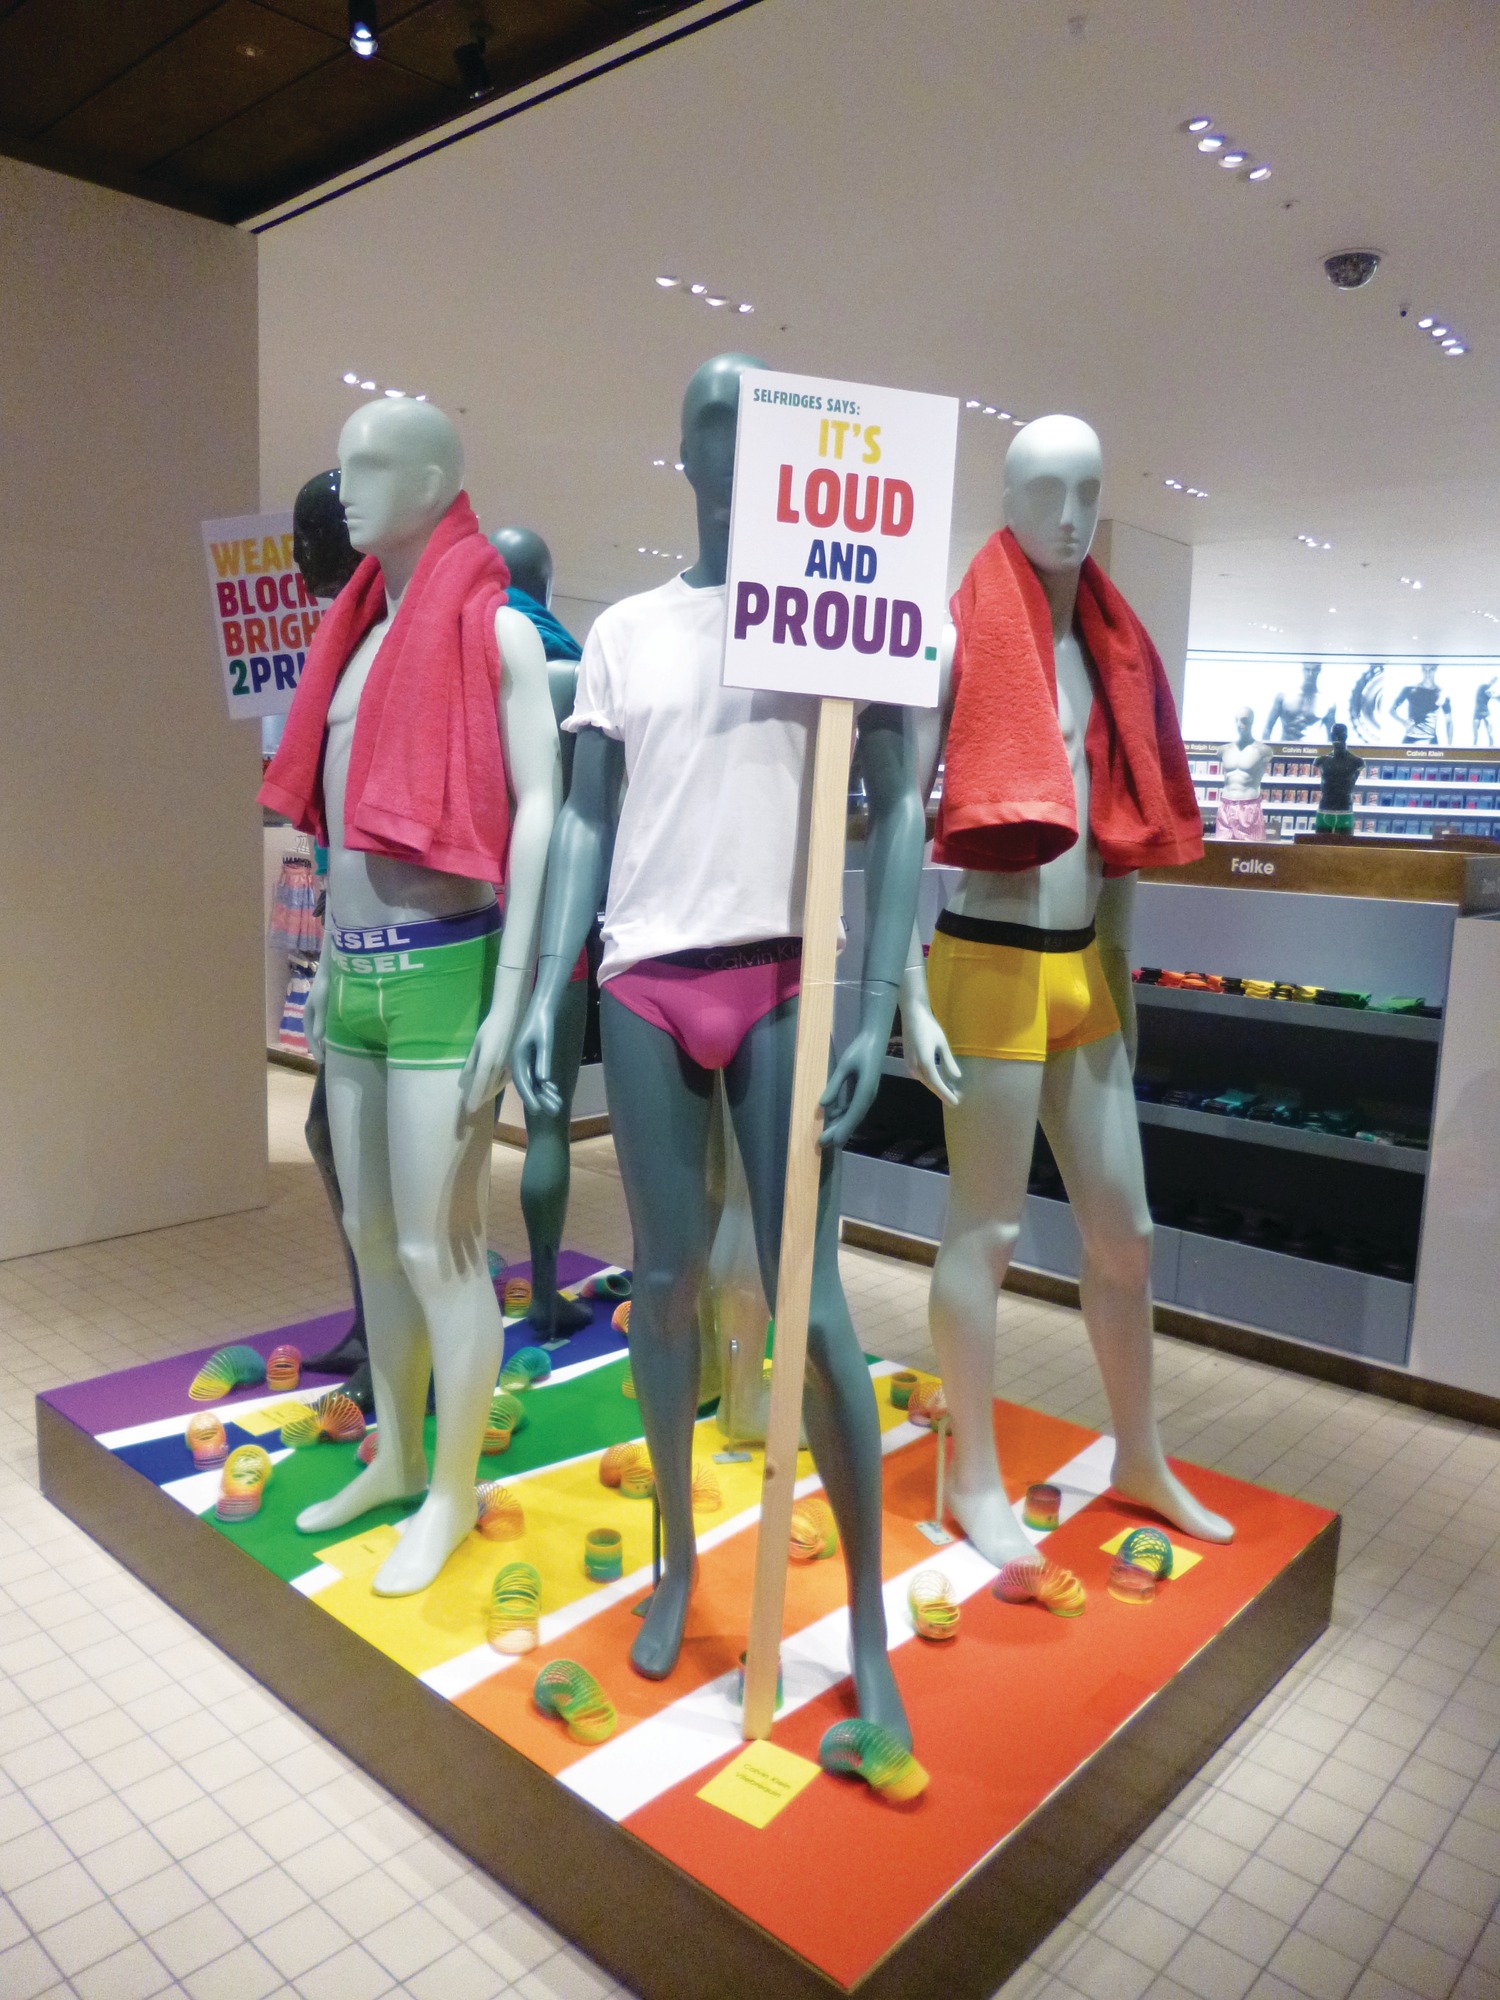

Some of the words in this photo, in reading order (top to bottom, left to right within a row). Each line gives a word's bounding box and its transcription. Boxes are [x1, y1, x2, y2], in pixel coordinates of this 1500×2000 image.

[753, 388, 822, 410] SELFRIDGES
[827, 398, 860, 415] SAYS:
[818, 418, 882, 464] IT'S
[776, 464, 915, 537] LOUD
[804, 539, 878, 584] AND
[222, 609, 327, 657] BRIGH
[734, 581, 937, 661] PROUD.
[1231, 857, 1275, 875] Falke
